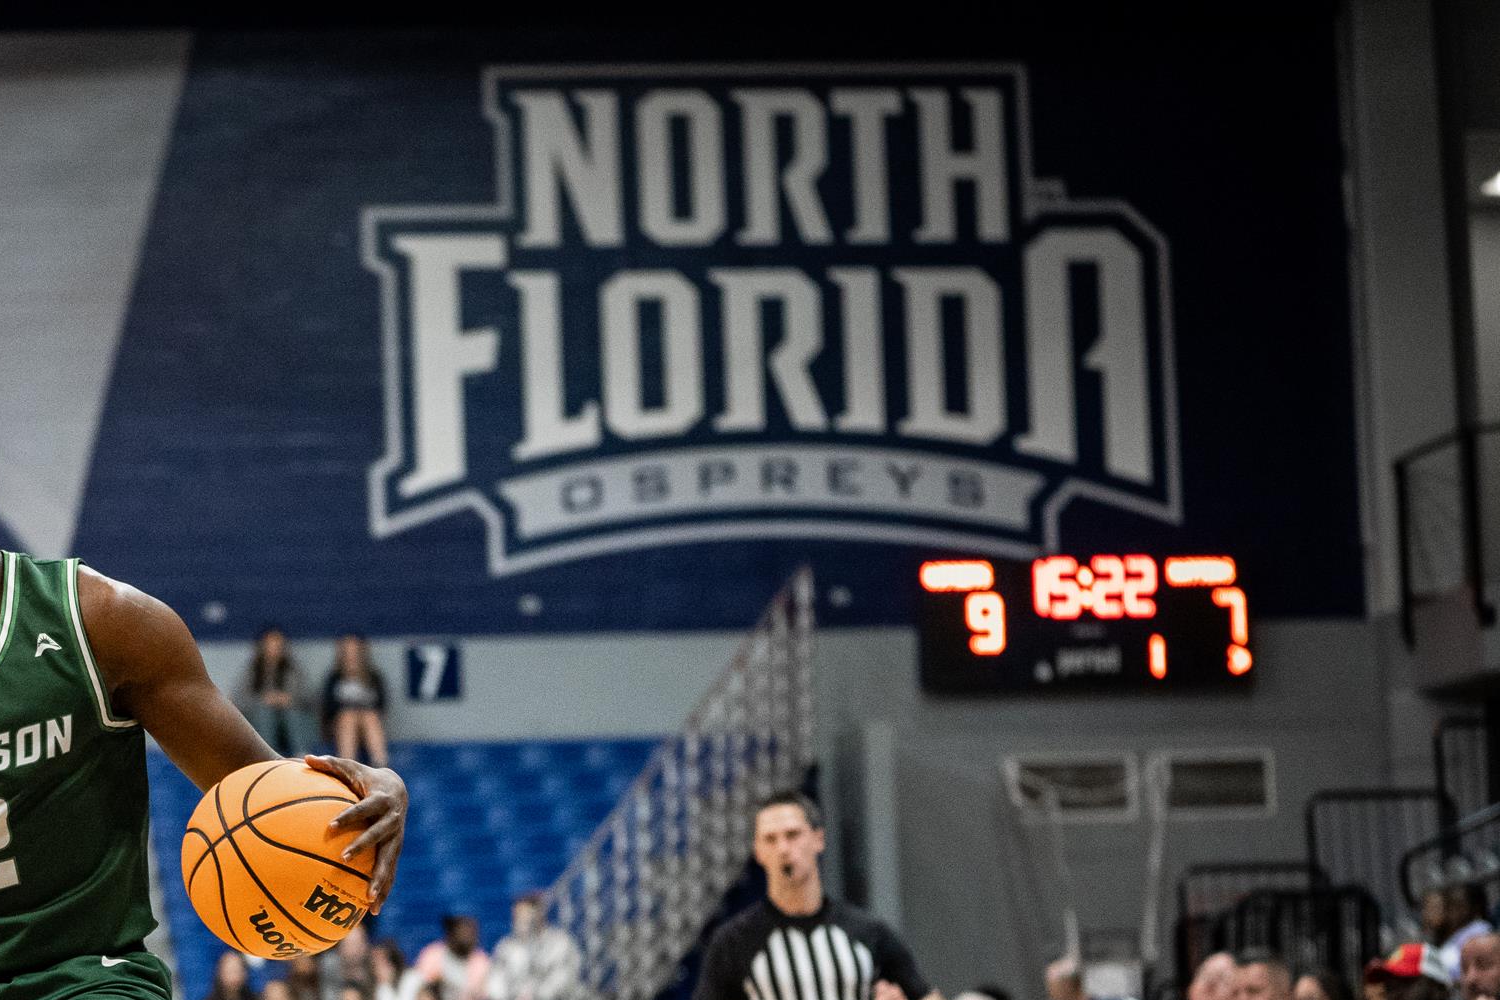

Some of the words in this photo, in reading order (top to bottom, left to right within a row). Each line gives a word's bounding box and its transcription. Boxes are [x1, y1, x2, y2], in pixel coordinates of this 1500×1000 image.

[508, 87, 1012, 249] NORTH
[390, 224, 1155, 501] FLORIDA
[559, 456, 989, 515] OSPREYS
[1031, 553, 1159, 620] 15:22
[965, 590, 1007, 656] 9
[1211, 586, 1249, 646] 7
[418, 645, 447, 699] 7
[249, 908, 303, 958] lson
[303, 884, 365, 929] NCAA
